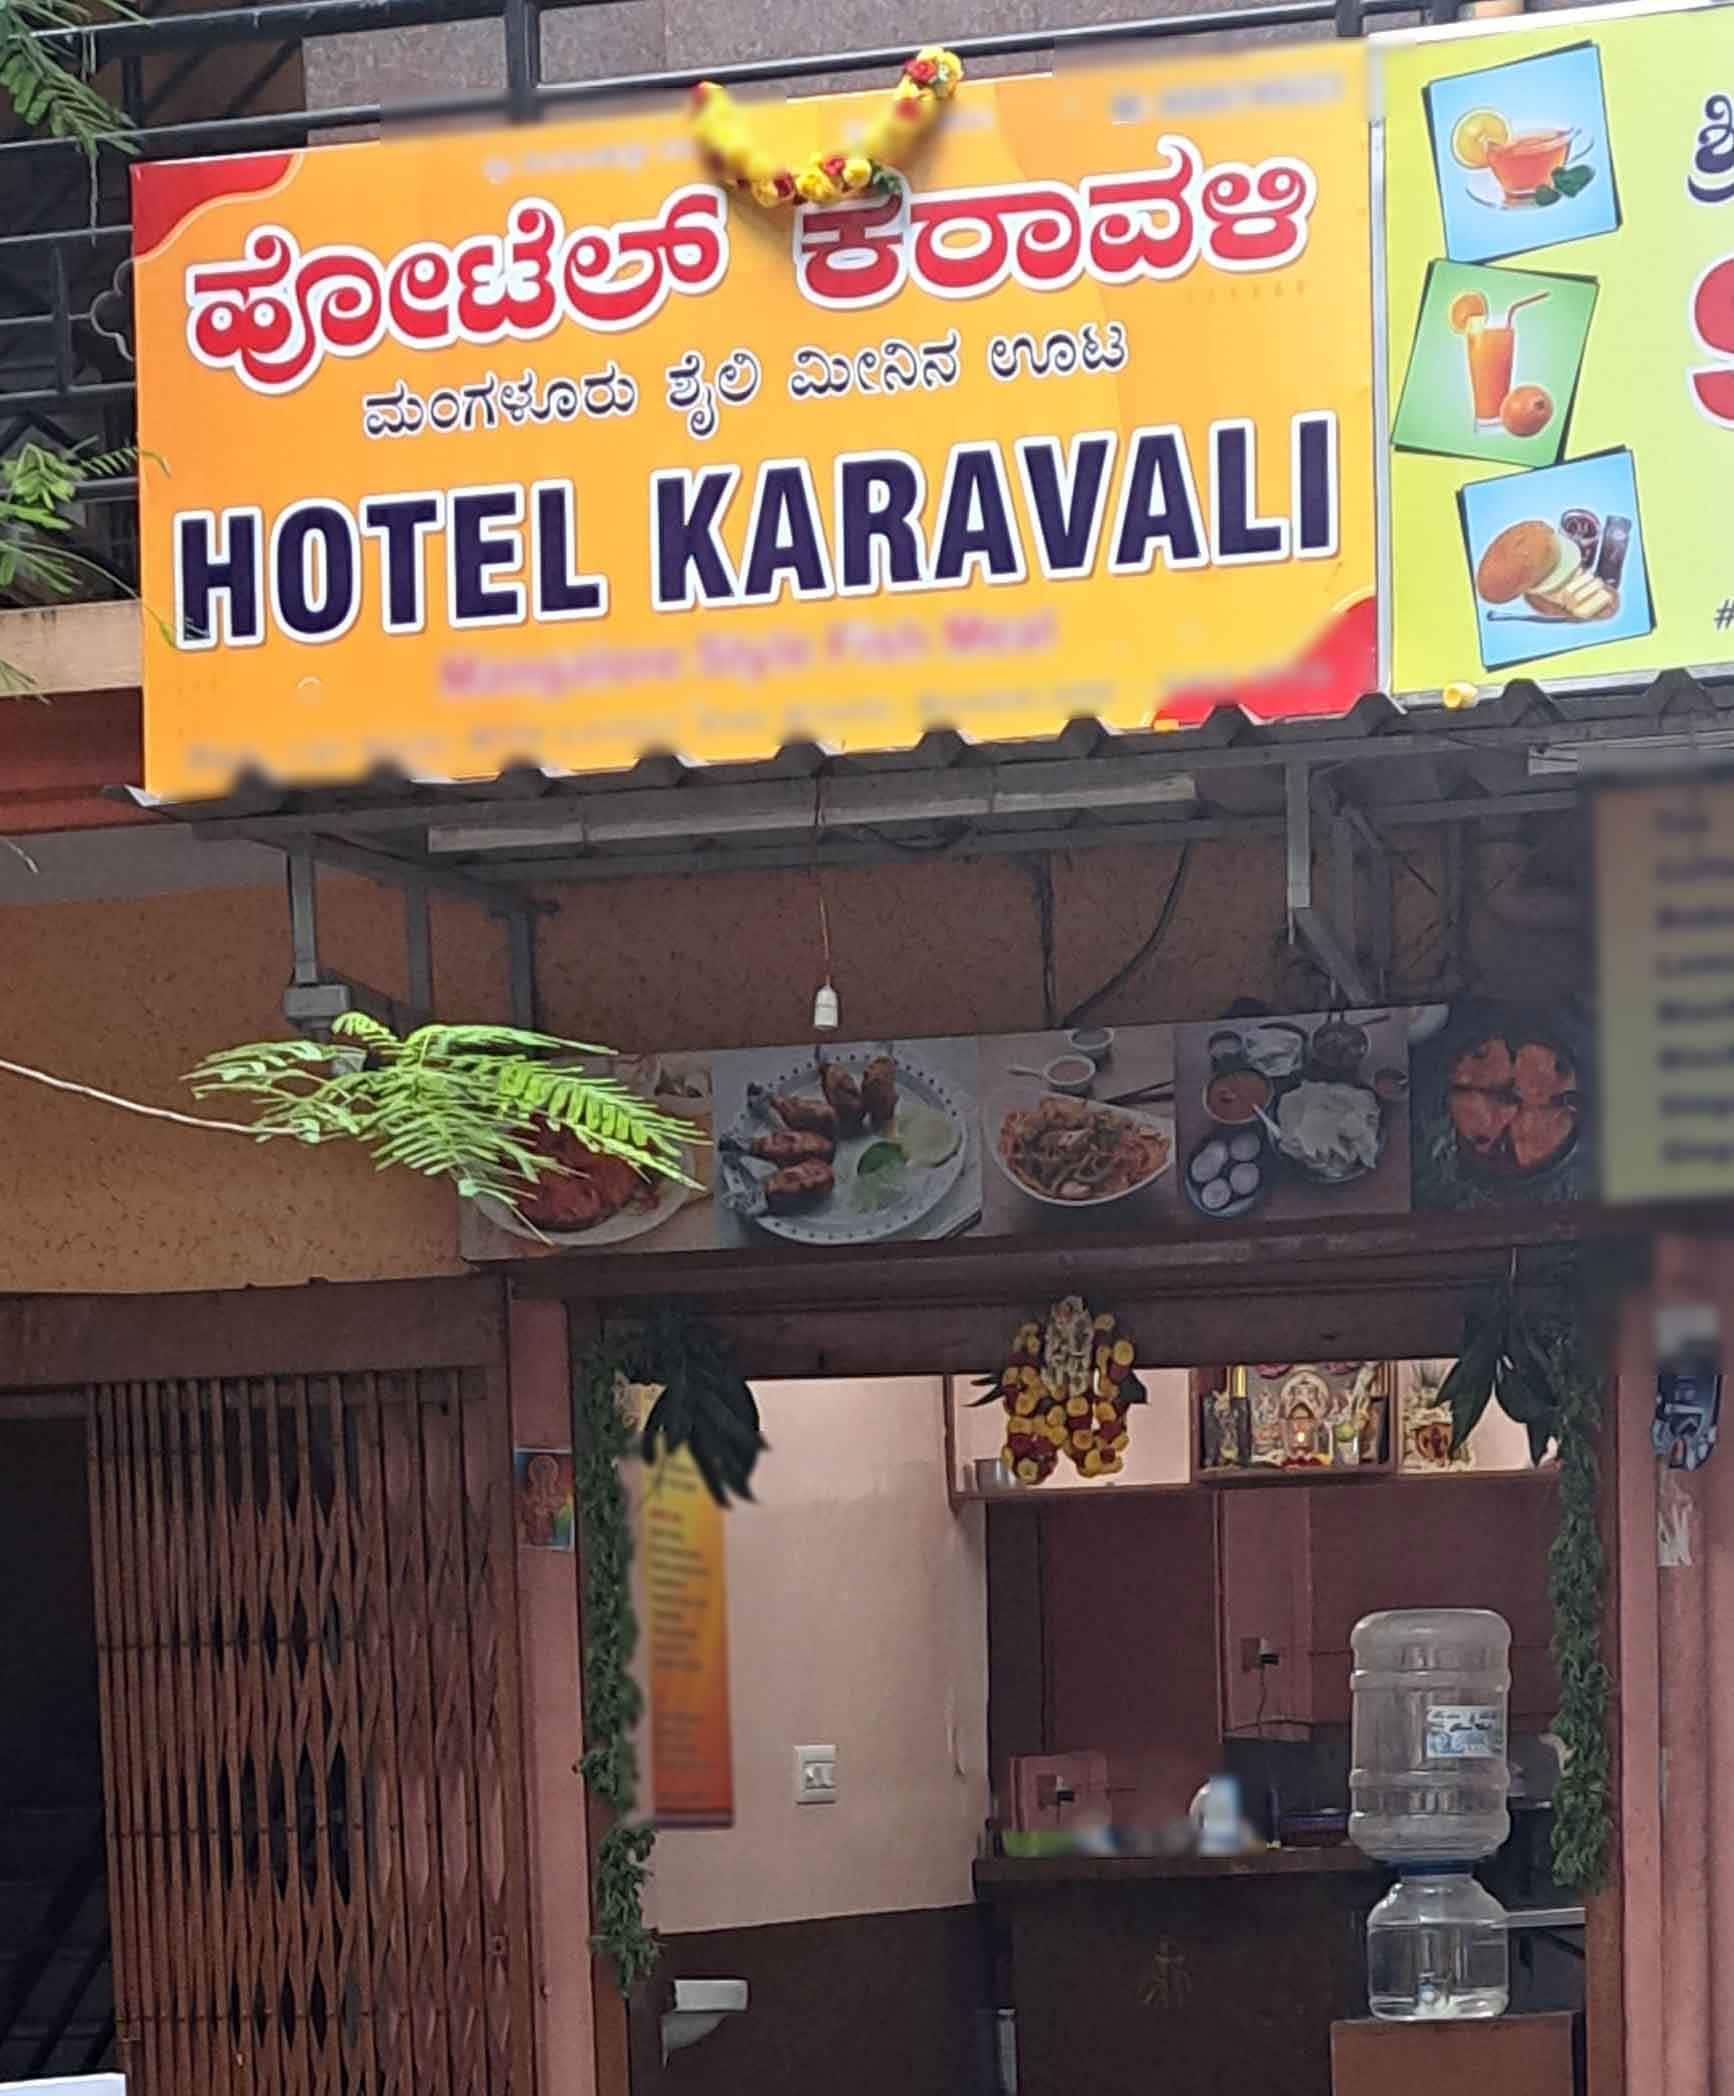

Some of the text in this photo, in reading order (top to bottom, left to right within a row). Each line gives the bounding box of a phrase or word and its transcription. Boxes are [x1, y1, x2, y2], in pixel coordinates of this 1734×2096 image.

[190, 138, 1312, 388] ಹೋಟೆಲ್ ಕರಾವಳಿ
[364, 324, 1126, 437] ಮಂಗಳೂರು ಶೈಲಿ ಮೀನಿನ ಊಟ
[179, 411, 1333, 643] HOTEL KARAVALI
